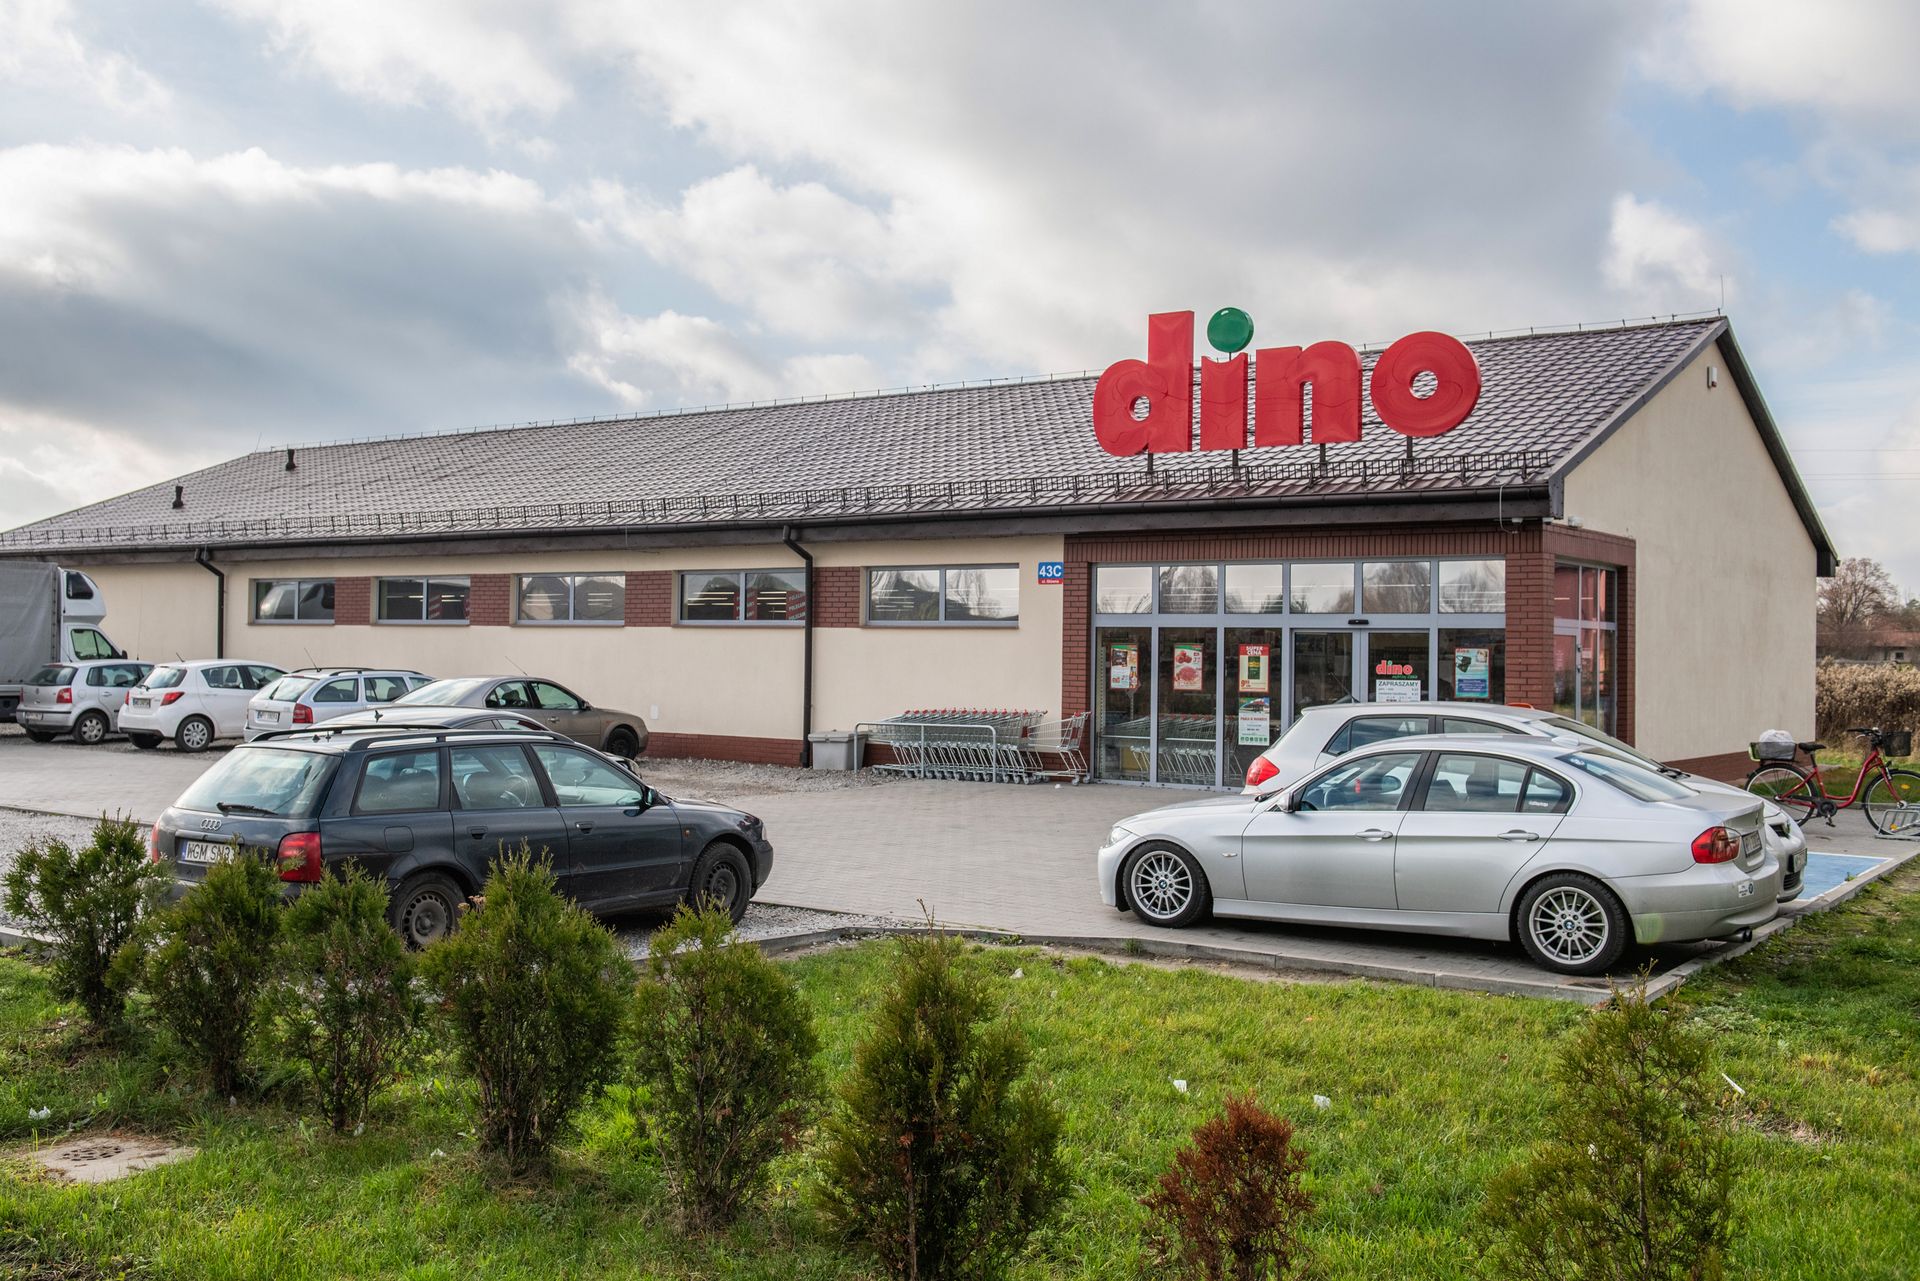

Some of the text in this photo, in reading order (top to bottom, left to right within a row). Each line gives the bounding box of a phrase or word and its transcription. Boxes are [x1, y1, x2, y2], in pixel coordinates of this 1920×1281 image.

[1092, 307, 1481, 457] dino
[1039, 565, 1062, 578] 43C
[1376, 660, 1413, 675] dino
[187, 842, 232, 860] WGM SN3
